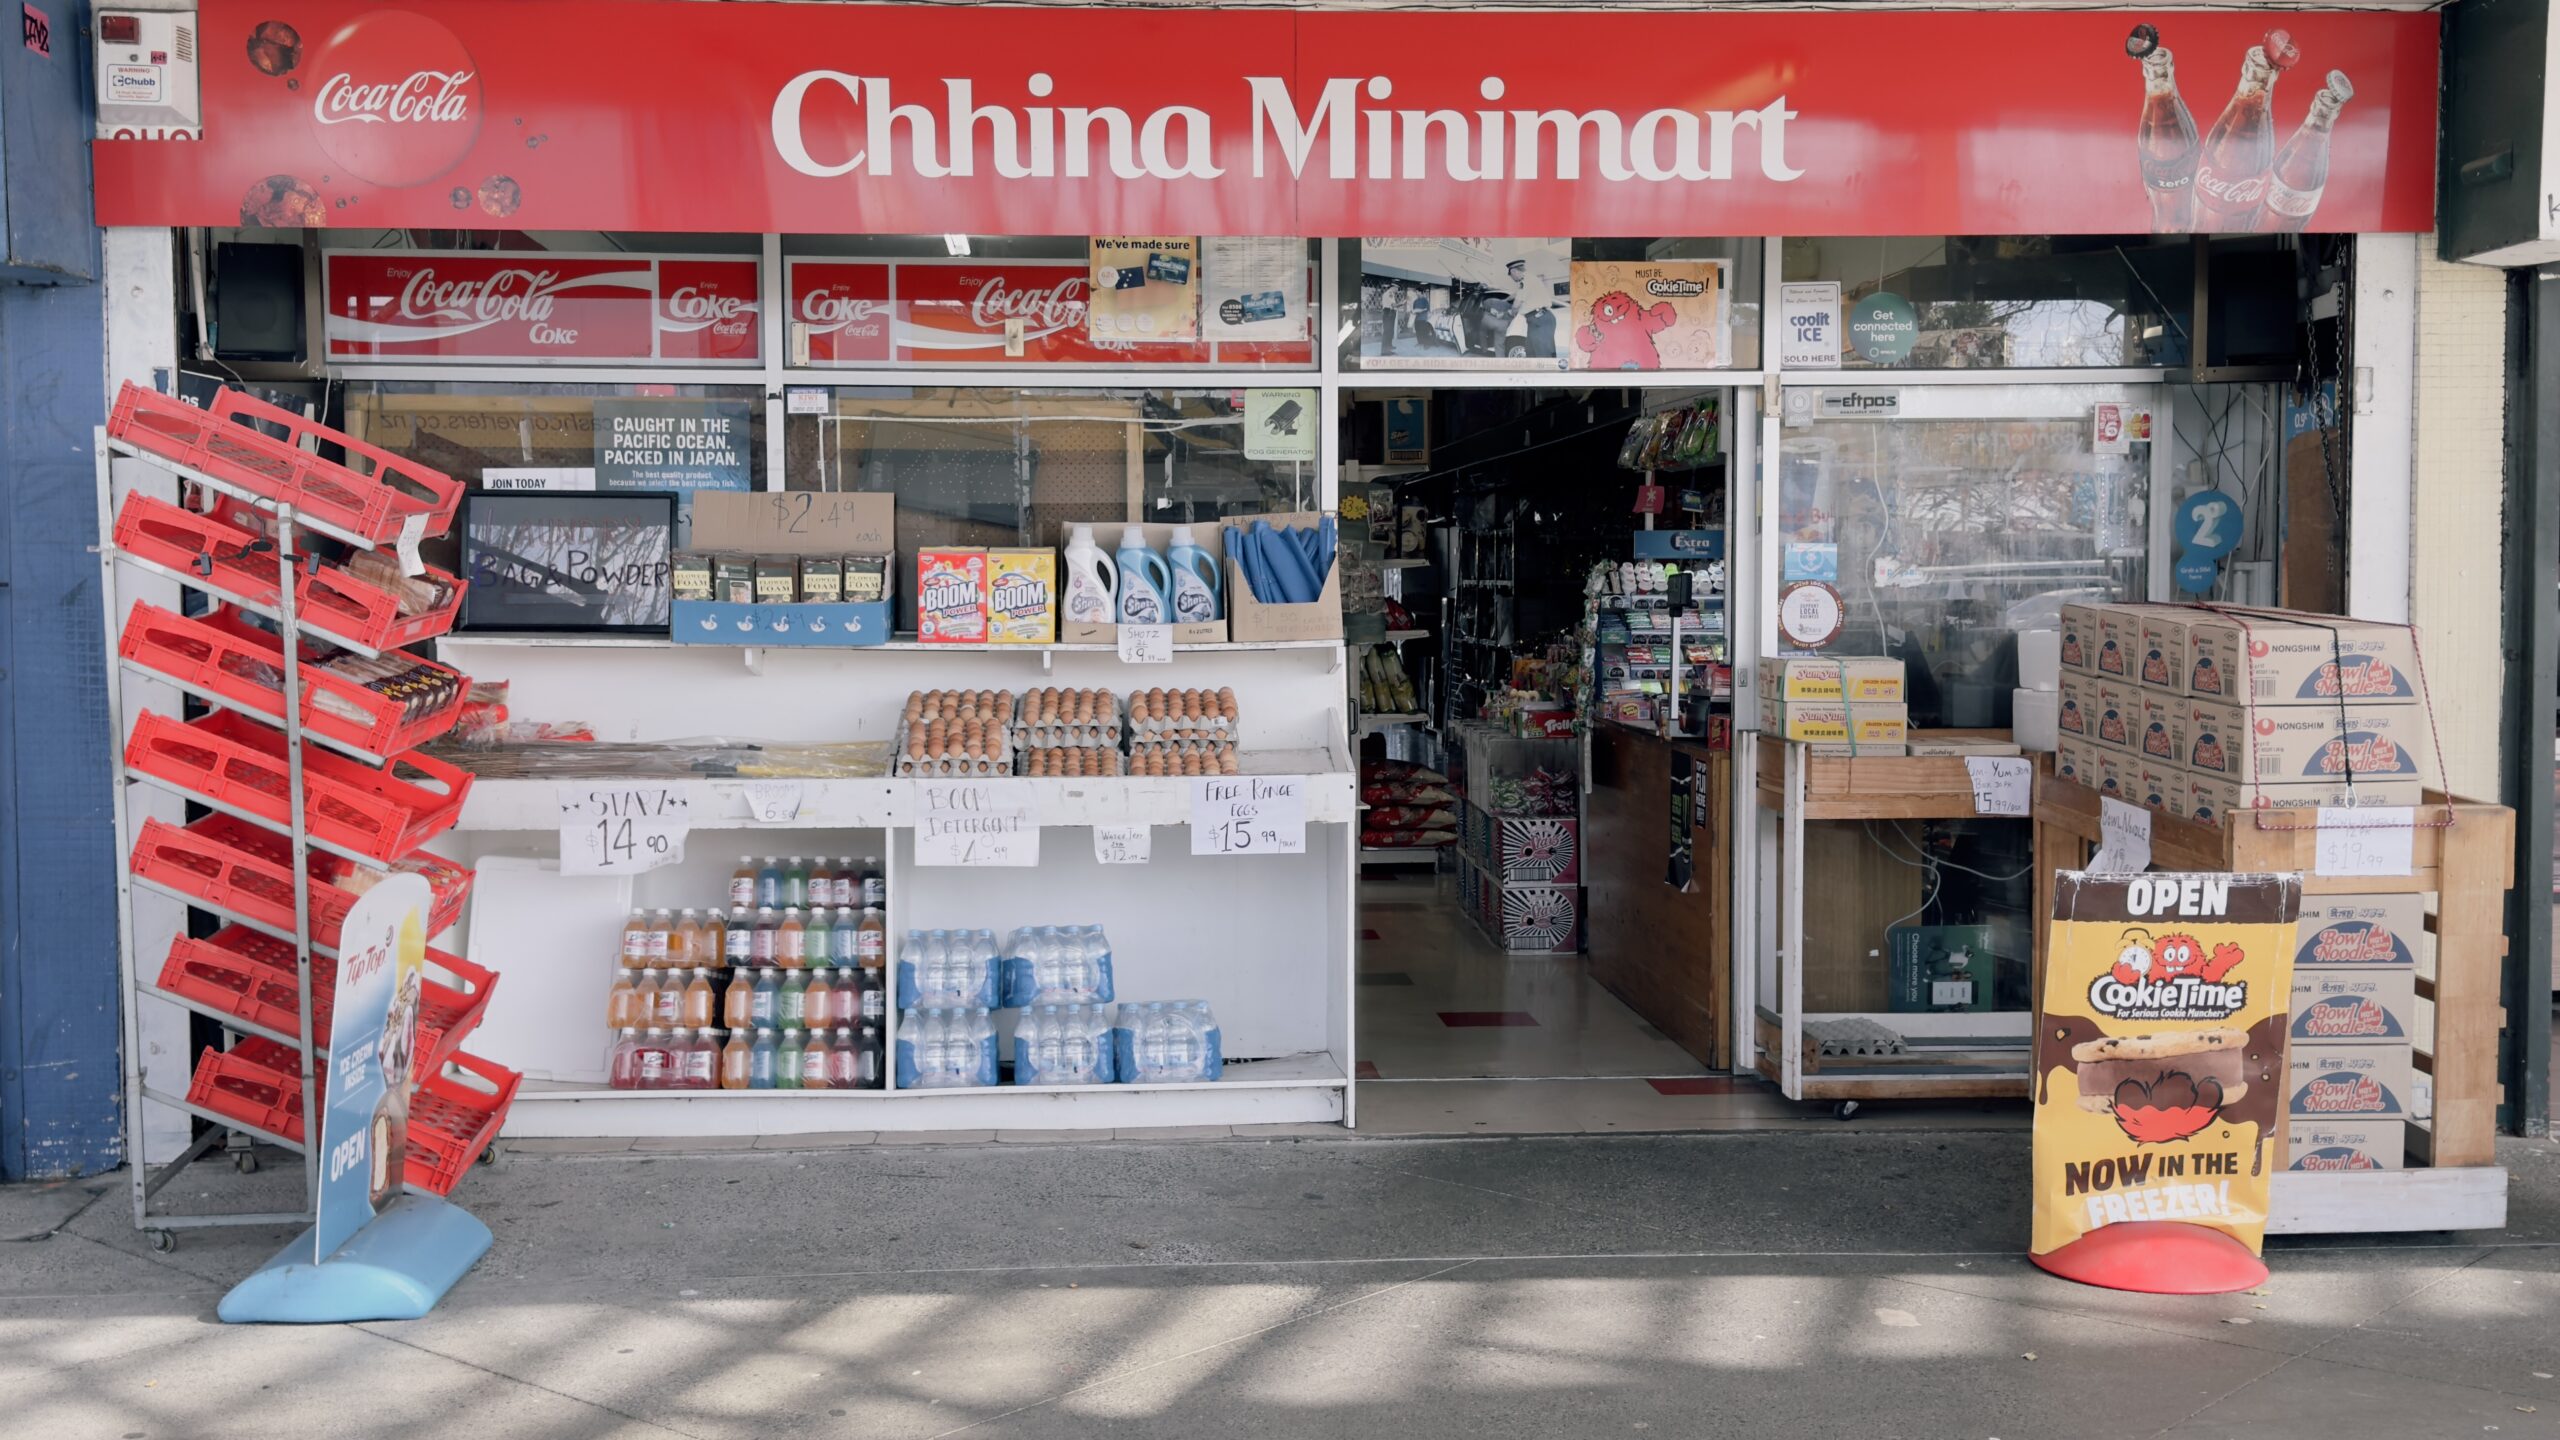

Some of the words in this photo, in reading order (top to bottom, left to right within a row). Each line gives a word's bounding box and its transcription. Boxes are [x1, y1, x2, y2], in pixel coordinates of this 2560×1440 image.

[124, 76, 156, 86] Chubb
[314, 71, 475, 124] Coca-Cola
[771, 69, 1226, 179] Chhina
[1243, 76, 1806, 182] Minimart
[2158, 176, 2190, 188] zero
[2196, 166, 2267, 202] Coca-Cola
[1095, 238, 1129, 249] We've
[1131, 239, 1162, 249] made
[1165, 241, 1190, 250] sure
[387, 267, 412, 280] Enjoy
[1636, 269, 1652, 278] MUST
[959, 276, 984, 288] Enjoy
[401, 268, 560, 322] Coca-Cola
[668, 286, 742, 319] Coke
[802, 289, 873, 321] Coke
[1790, 312, 1830, 327] coolit
[1873, 310, 1893, 320] Get
[529, 322, 578, 345] Coke
[713, 322, 748, 336] Coca-Cola
[1854, 321, 1912, 331] connected
[1797, 328, 1823, 342] ICE
[1871, 332, 1895, 342] here
[1365, 359, 1386, 368] YOU
[1451, 359, 1479, 368] WITH
[1784, 355, 1808, 363] SOLD
[1811, 355, 1836, 363] HERE
[1842, 392, 1896, 409] eftpos
[613, 417, 675, 433] CAUGHT
[681, 418, 696, 433] IN
[701, 418, 731, 433] THE
[613, 434, 671, 449] PACIFIC
[676, 435, 731, 449] OCEAN.
[605, 450, 663, 466] PACKED
[668, 451, 683, 465] IN
[689, 451, 741, 466] JAPAN.
[491, 478, 511, 489] JOIN
[514, 478, 546, 489] TODAY
[609, 478, 636, 487] because
[648, 479, 667, 487] select
[669, 479, 680, 487] the
[681, 479, 696, 487] best
[698, 479, 720, 489] quality
[722, 479, 737, 487] fish.
[632, 470, 643, 479] The
[645, 470, 660, 479] best
[662, 471, 684, 481] quality
[856, 528, 882, 543] each
[1675, 535, 1710, 548] Extra
[474, 551, 543, 588] BAG
[568, 550, 668, 586] POWDER
[2180, 566, 2194, 574] Grab
[676, 579, 708, 587] FOAM
[760, 585, 790, 593] FOAM
[926, 582, 977, 612] BOOM
[994, 582, 1045, 613] BOOM
[944, 605, 977, 615] POWER
[1011, 605, 1045, 616] POWER
[1128, 627, 1160, 639] SHOTZ
[2272, 644, 2321, 653] NONGSHIM
[2320, 662, 2367, 680] Bowl
[2315, 679, 2373, 695] Noodle
[2276, 721, 2324, 730] NONGSHIM
[2326, 739, 2371, 757] Bowl
[1992, 760, 2012, 777] YUM
[2320, 756, 2378, 773] Noodle
[1205, 780, 1241, 802] FREE
[1249, 777, 1295, 801] RANGE
[927, 787, 993, 812] BOOM
[2272, 799, 2321, 808] NONGSHIM
[1231, 803, 1259, 817] EGGS
[923, 815, 1021, 845] DETERGENT
[2126, 879, 2229, 917] OPEN
[2319, 928, 2367, 946] Bowl
[1911, 933, 1920, 963] Choose
[2313, 944, 2373, 961] Noodle
[346, 953, 364, 986] Tip
[366, 944, 387, 978] Top
[1911, 965, 1919, 986] more
[1910, 987, 1919, 1003] you
[2117, 1008, 2130, 1017] For
[2131, 1009, 2159, 1017] Serious
[2160, 1009, 2186, 1017] Cookie
[2311, 1002, 2358, 1020] Bowl
[2305, 1019, 2363, 1036] Noodle
[339, 1057, 351, 1076] ICE
[350, 1040, 374, 1070] CREAM
[344, 1063, 367, 1092] INSIDE
[2309, 1079, 2356, 1097] Bowl
[2303, 1096, 2363, 1112] Noodle
[330, 1126, 367, 1183] OPEN
[2065, 1153, 2153, 1196] NOW
[2158, 1157, 2185, 1178] IN
[2191, 1151, 2239, 1175] THE
[2085, 1180, 2230, 1230] FREEZER!
